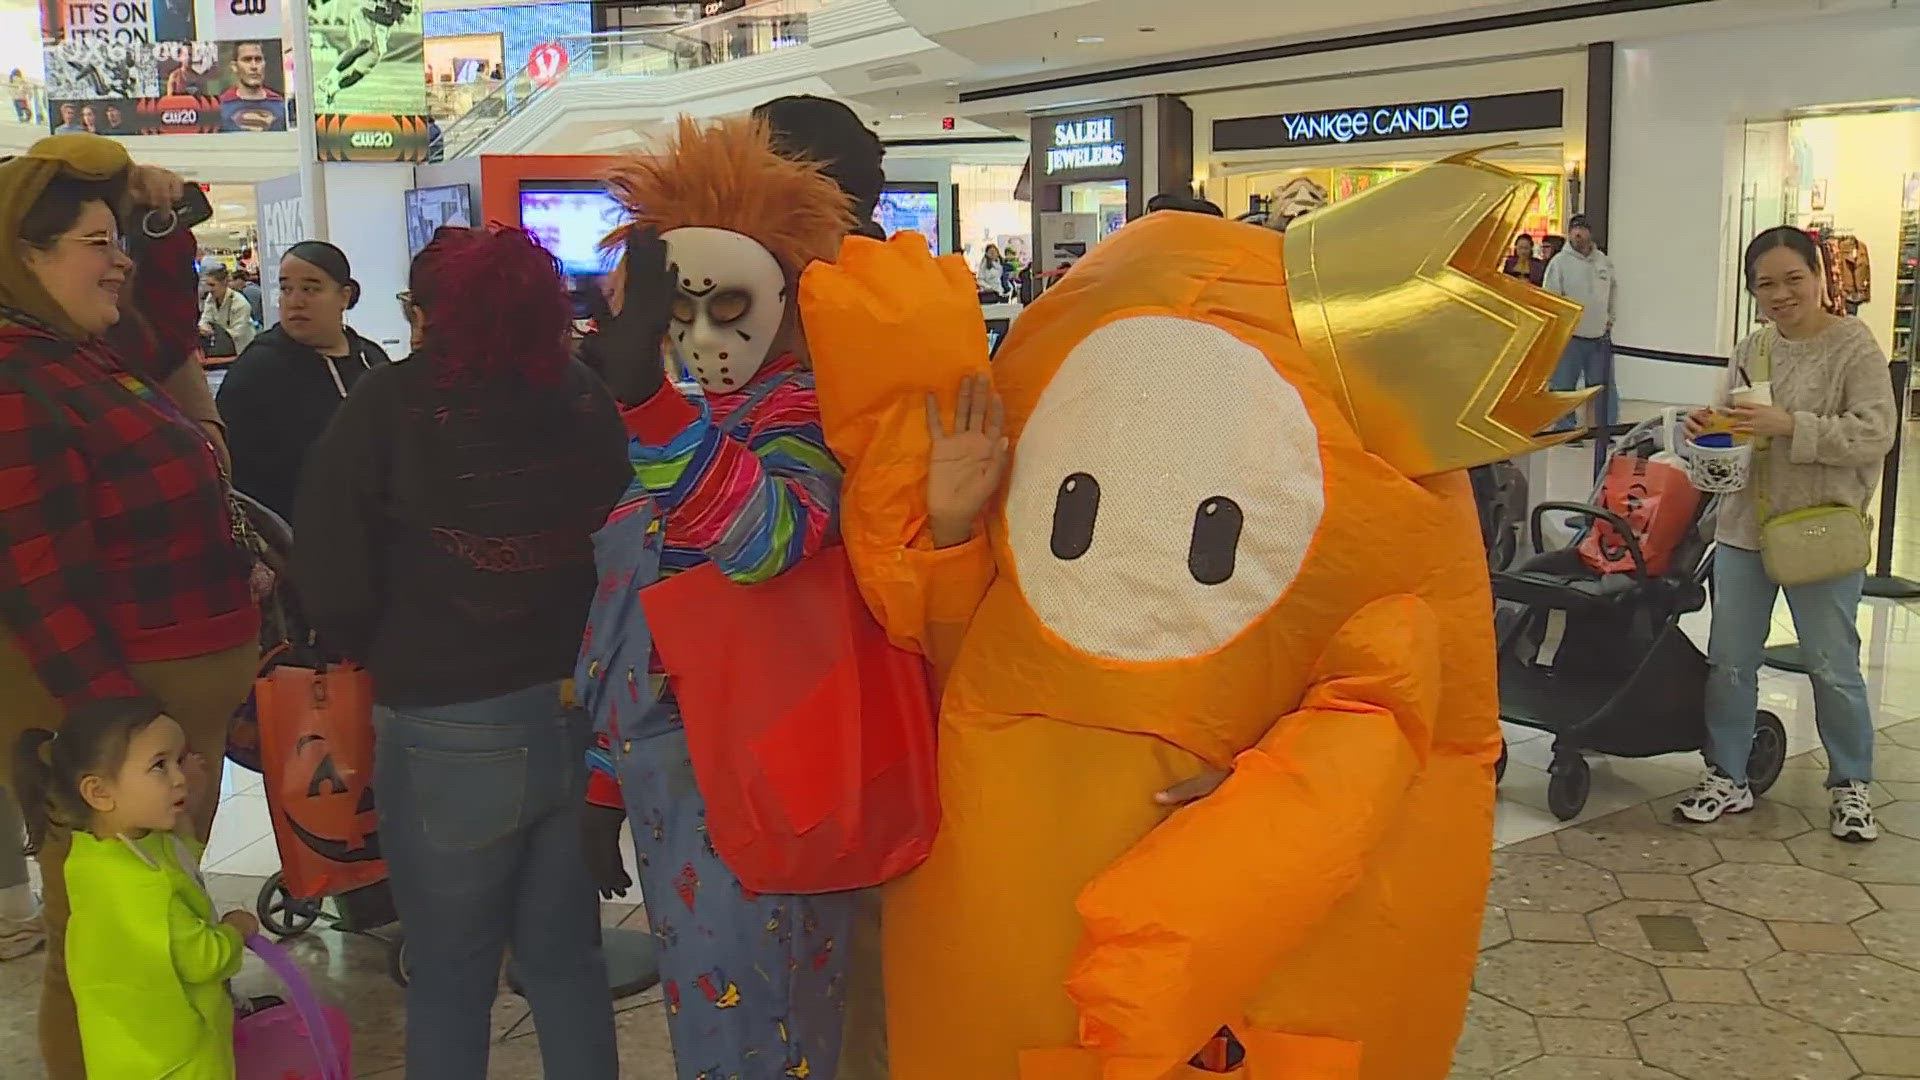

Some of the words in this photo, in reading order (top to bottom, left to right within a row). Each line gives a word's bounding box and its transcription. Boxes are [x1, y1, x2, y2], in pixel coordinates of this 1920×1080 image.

[69, 3, 108, 24] IT'S
[113, 2, 147, 23] ON
[1055, 119, 1111, 146] SALEH
[1046, 145, 1123, 175] JEWELERS
